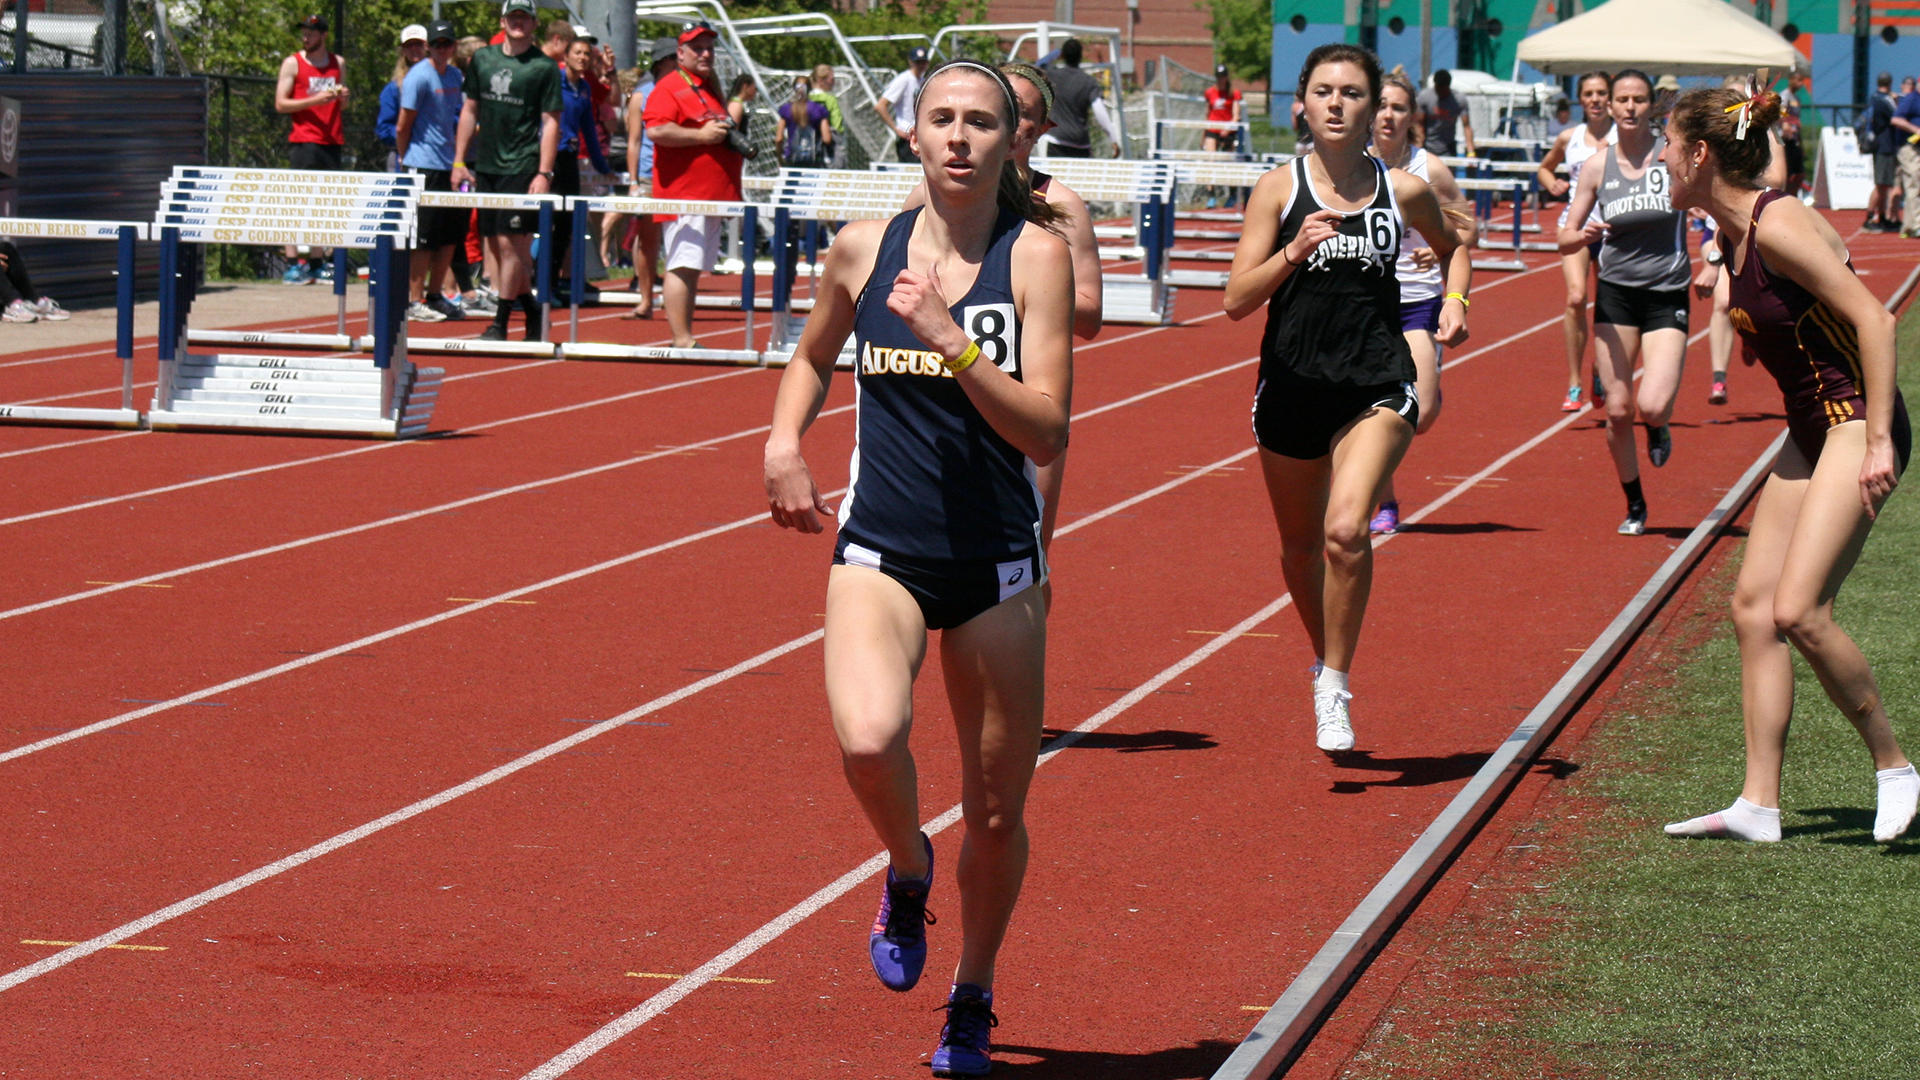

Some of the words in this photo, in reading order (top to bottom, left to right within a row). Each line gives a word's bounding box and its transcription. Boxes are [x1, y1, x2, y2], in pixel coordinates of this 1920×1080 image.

[1649, 169, 1664, 194] 9
[642, 203, 682, 212] GOLDEN
[686, 204, 718, 213] BEARS
[1603, 196, 1634, 222] MINOT
[1634, 194, 1673, 213] STATE
[0, 222, 41, 235] OLDEN
[47, 223, 87, 236] BEARS
[1370, 211, 1392, 251] 6
[213, 228, 243, 240] CSP
[248, 230, 297, 243] GOLDEN
[303, 232, 344, 245] BEARS
[971, 309, 1008, 367] 8
[259, 358, 287, 368] GILL
[271, 370, 299, 380] GILL
[250, 381, 278, 391] GILL
[265, 394, 294, 404] GILL
[259, 405, 287, 414] GILL
